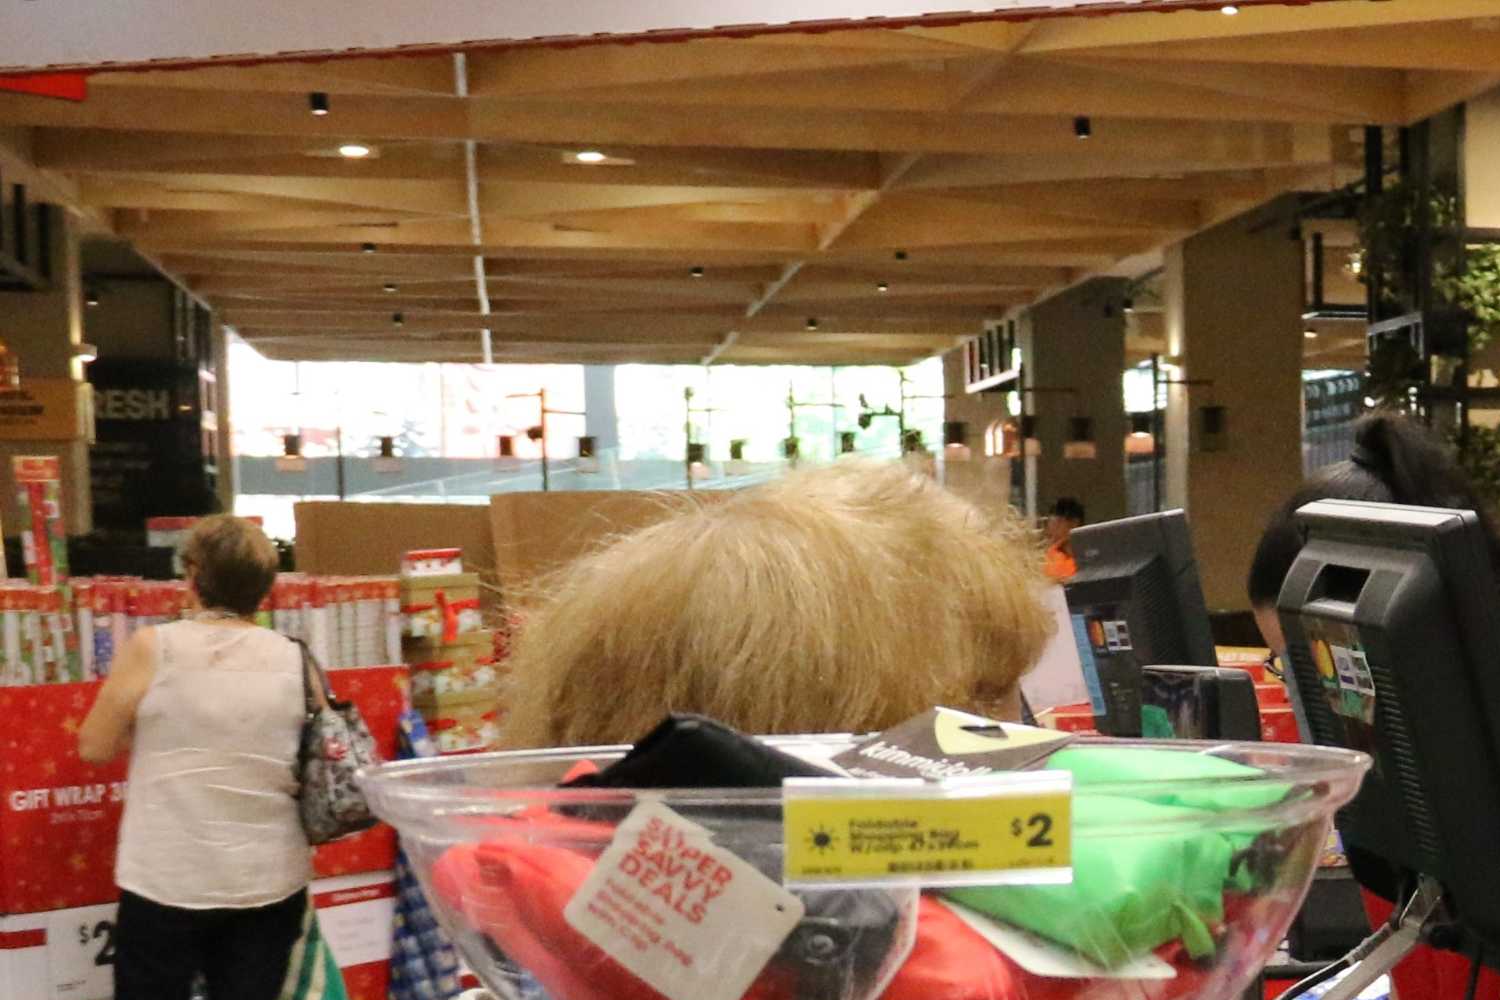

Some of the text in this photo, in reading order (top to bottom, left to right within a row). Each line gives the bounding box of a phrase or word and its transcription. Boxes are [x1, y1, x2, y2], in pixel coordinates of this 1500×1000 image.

[9, 783, 108, 812] GIFT WRAP
[1010, 811, 1054, 848] $2
[617, 852, 707, 925] DEALS
[637, 839, 726, 905] SAVVY
[78, 919, 116, 967] $2
